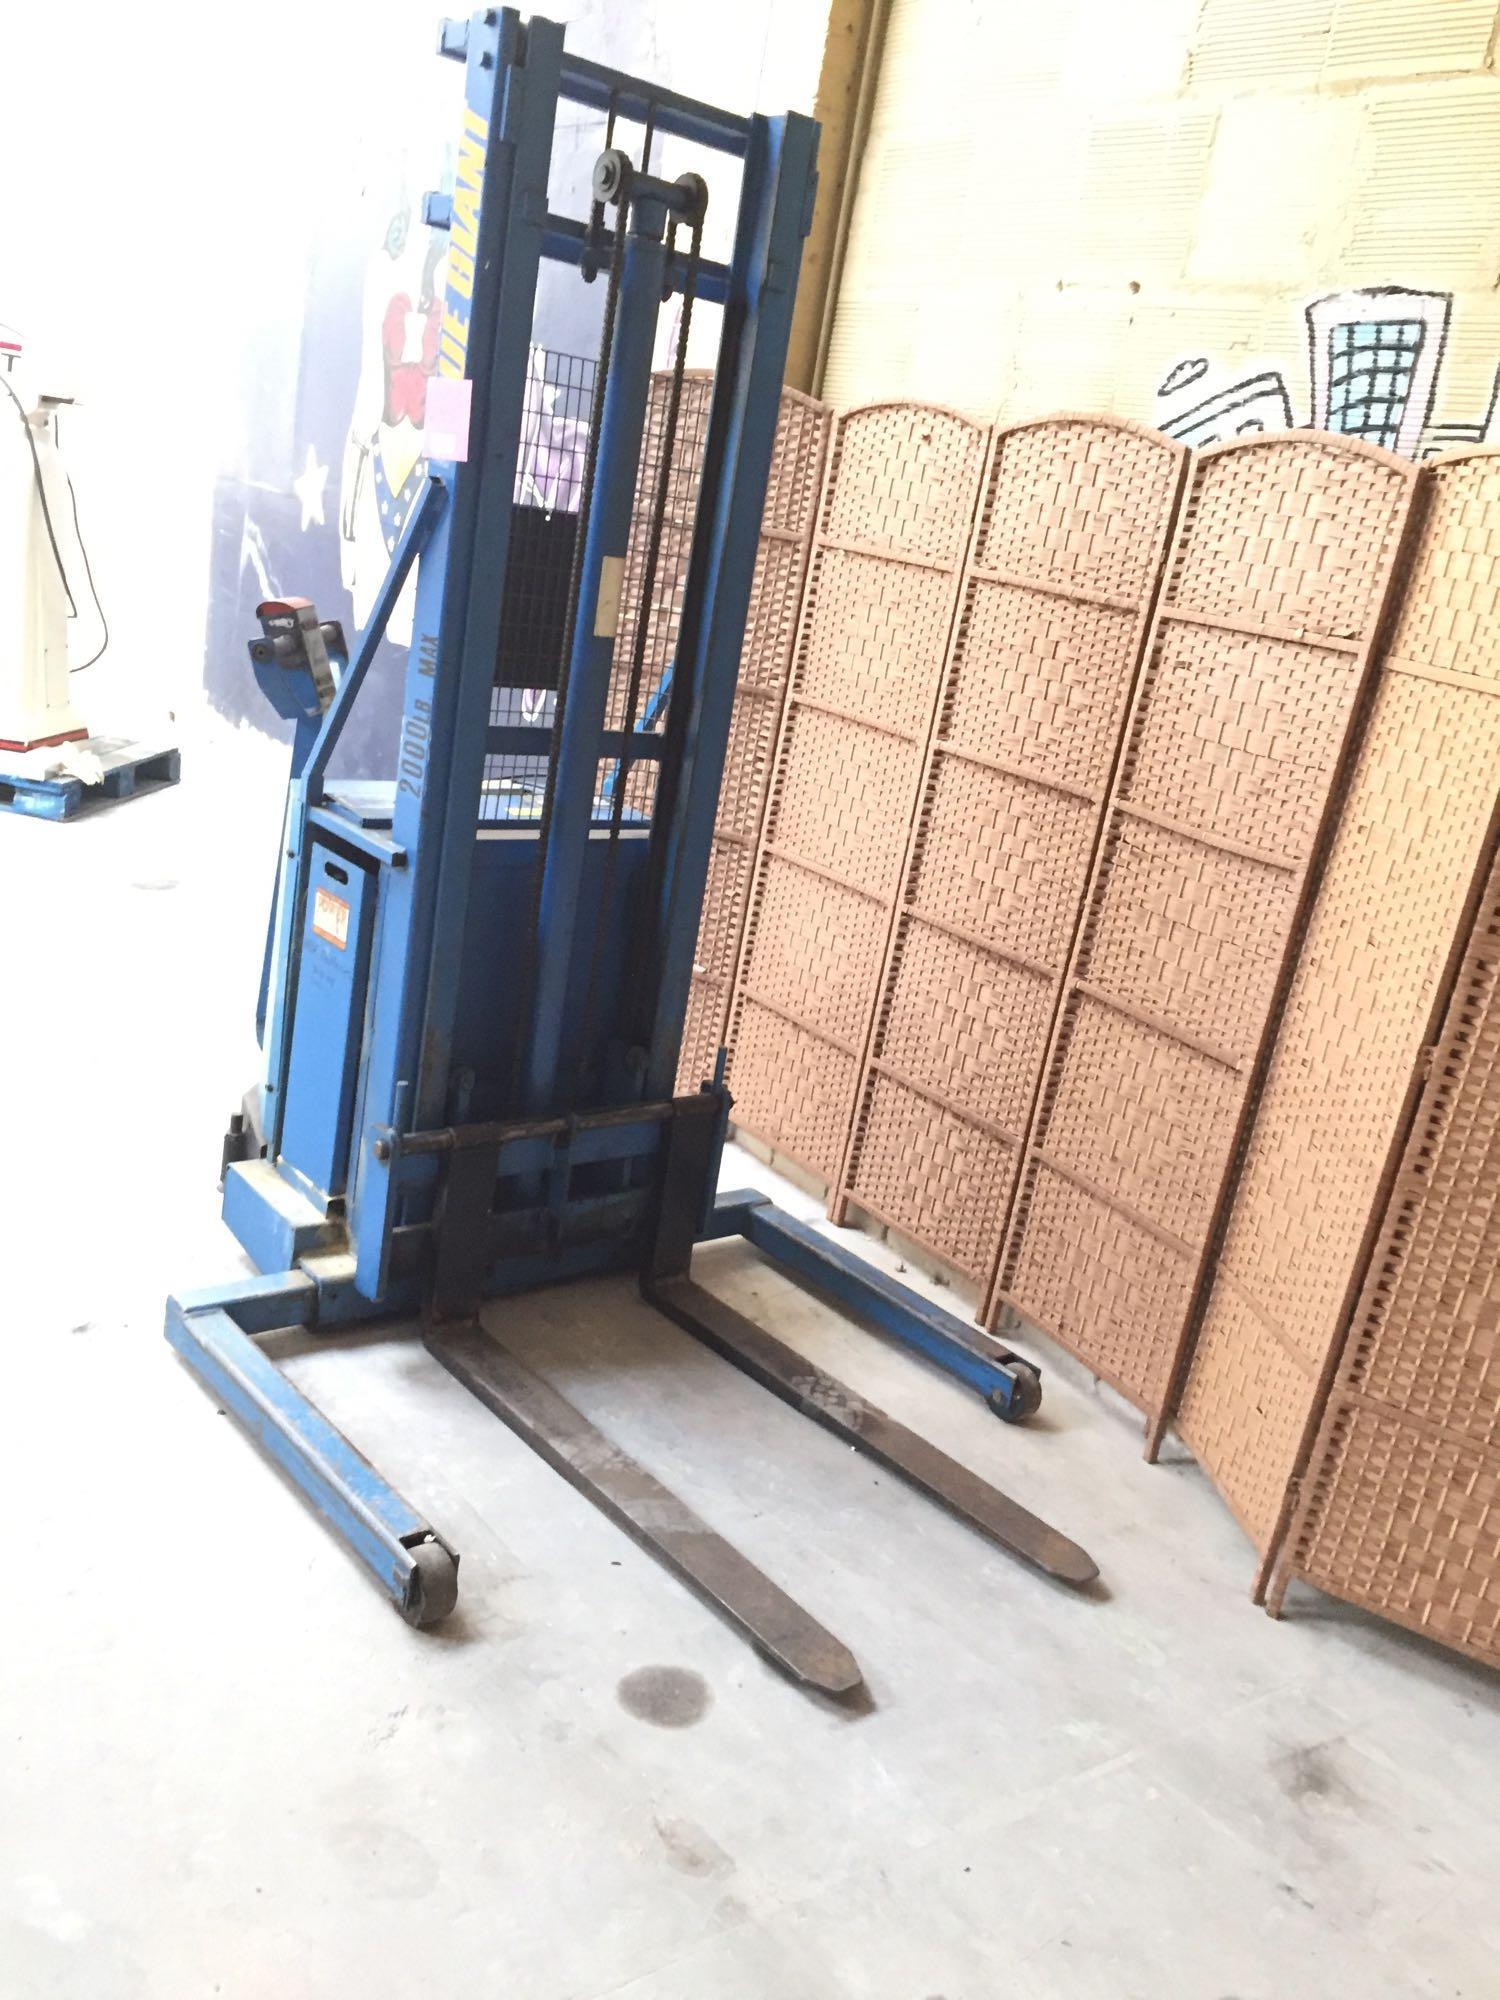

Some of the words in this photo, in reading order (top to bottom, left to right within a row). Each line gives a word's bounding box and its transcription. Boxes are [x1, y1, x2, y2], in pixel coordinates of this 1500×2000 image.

[446, 107, 488, 300] GIANT
[438, 303, 469, 379] UE
[418, 632, 439, 678] MAX
